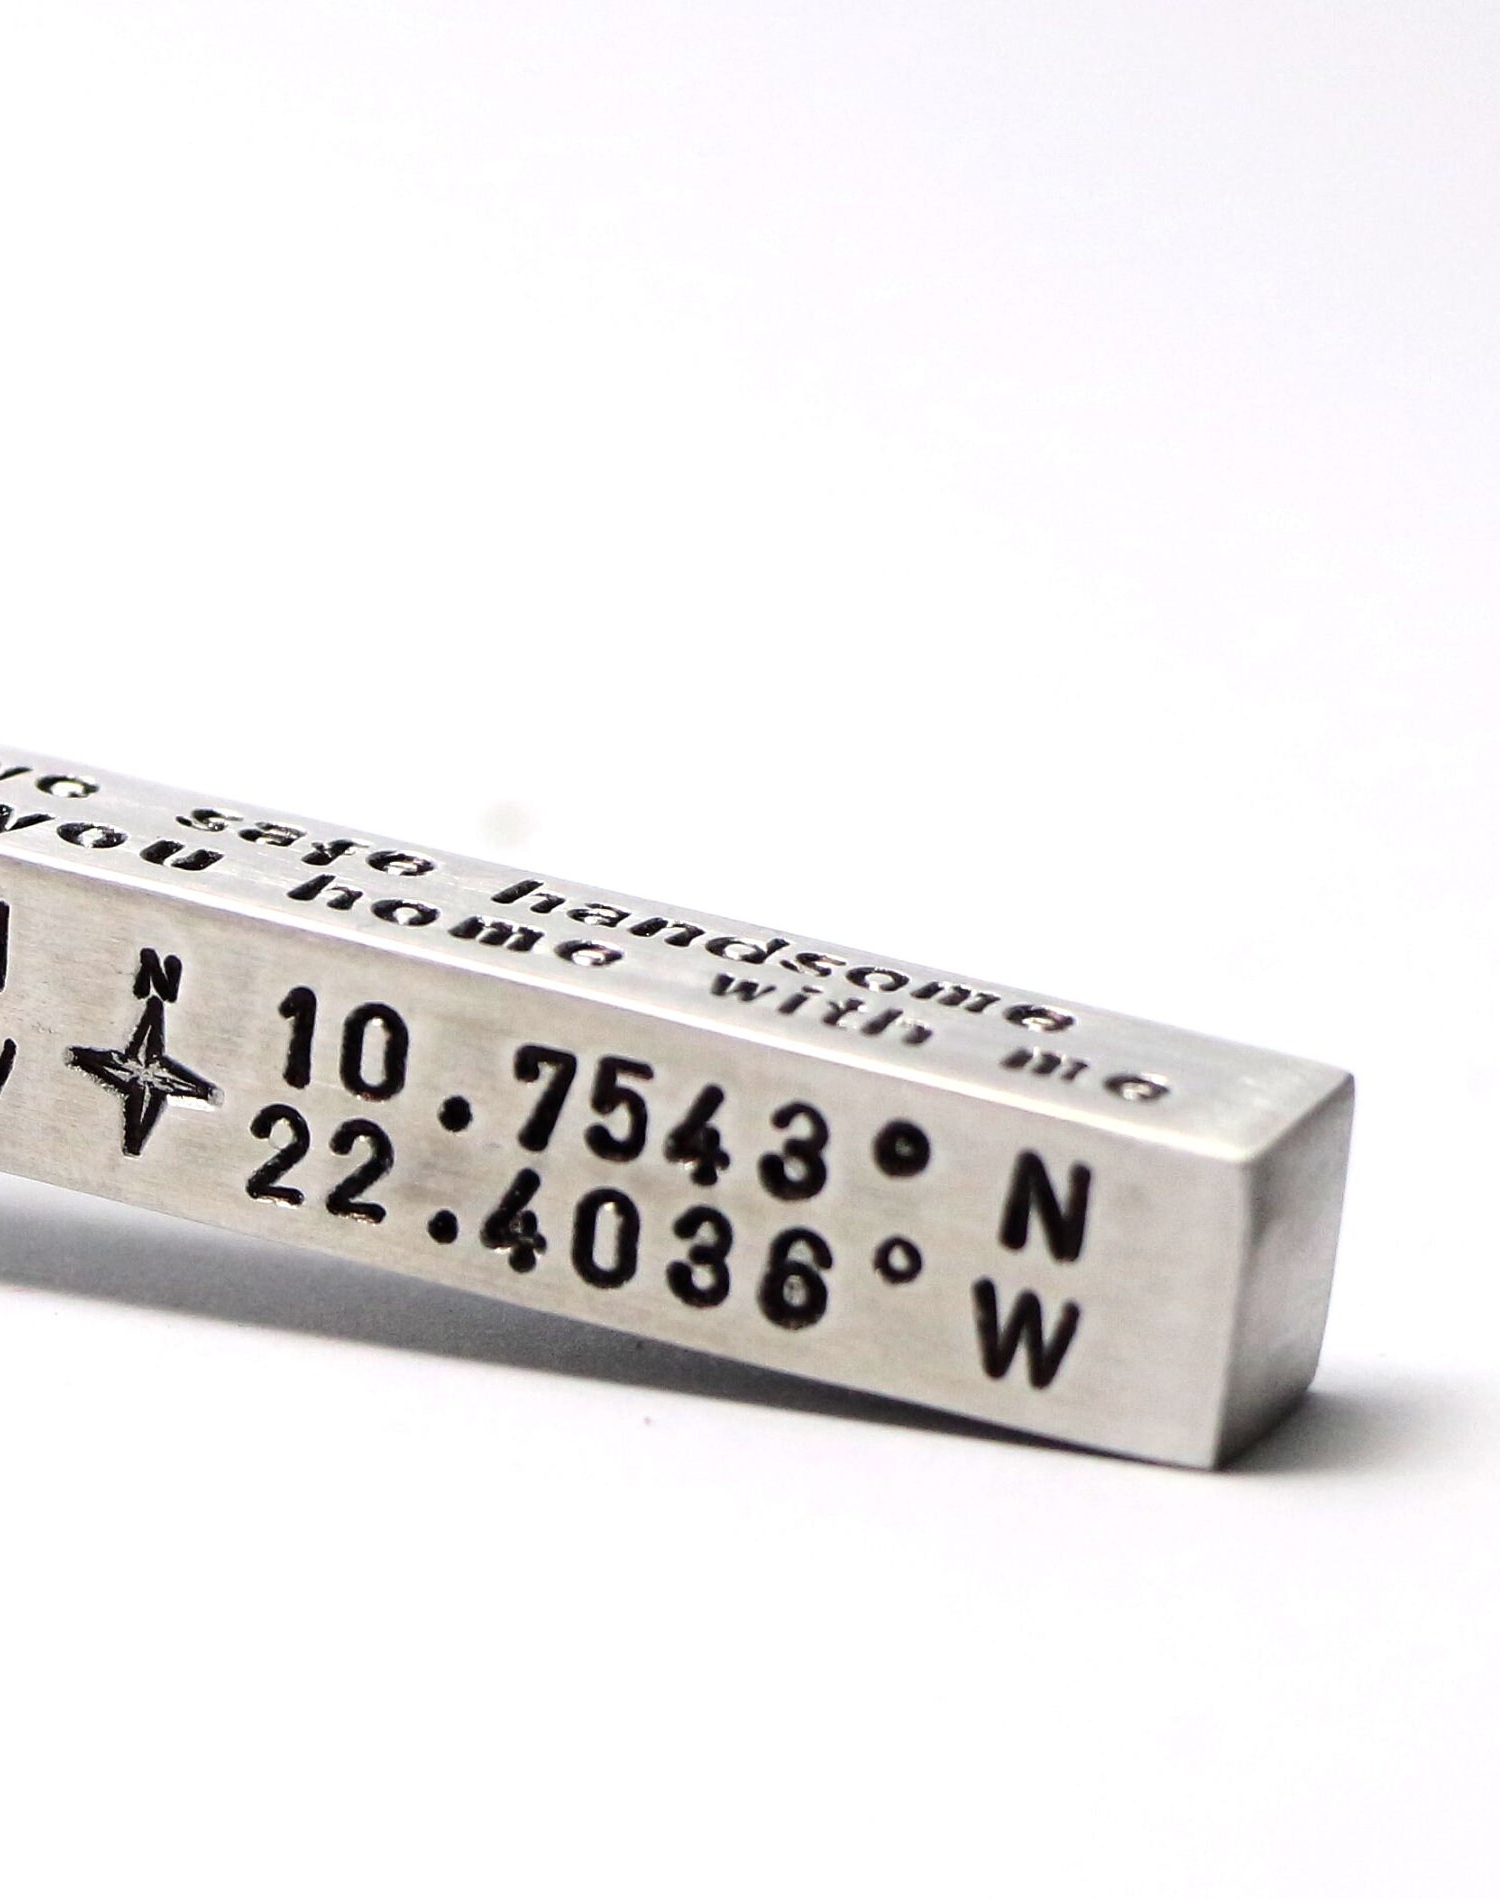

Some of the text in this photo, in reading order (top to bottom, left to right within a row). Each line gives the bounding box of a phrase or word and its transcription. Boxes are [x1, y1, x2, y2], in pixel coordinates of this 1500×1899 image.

[134, 947, 182, 1003] N
[175, 807, 437, 876] safe
[490, 879, 1077, 1031] handsome
[287, 873, 624, 966] home
[711, 972, 933, 1044] with
[1000, 1047, 1171, 1101] me
